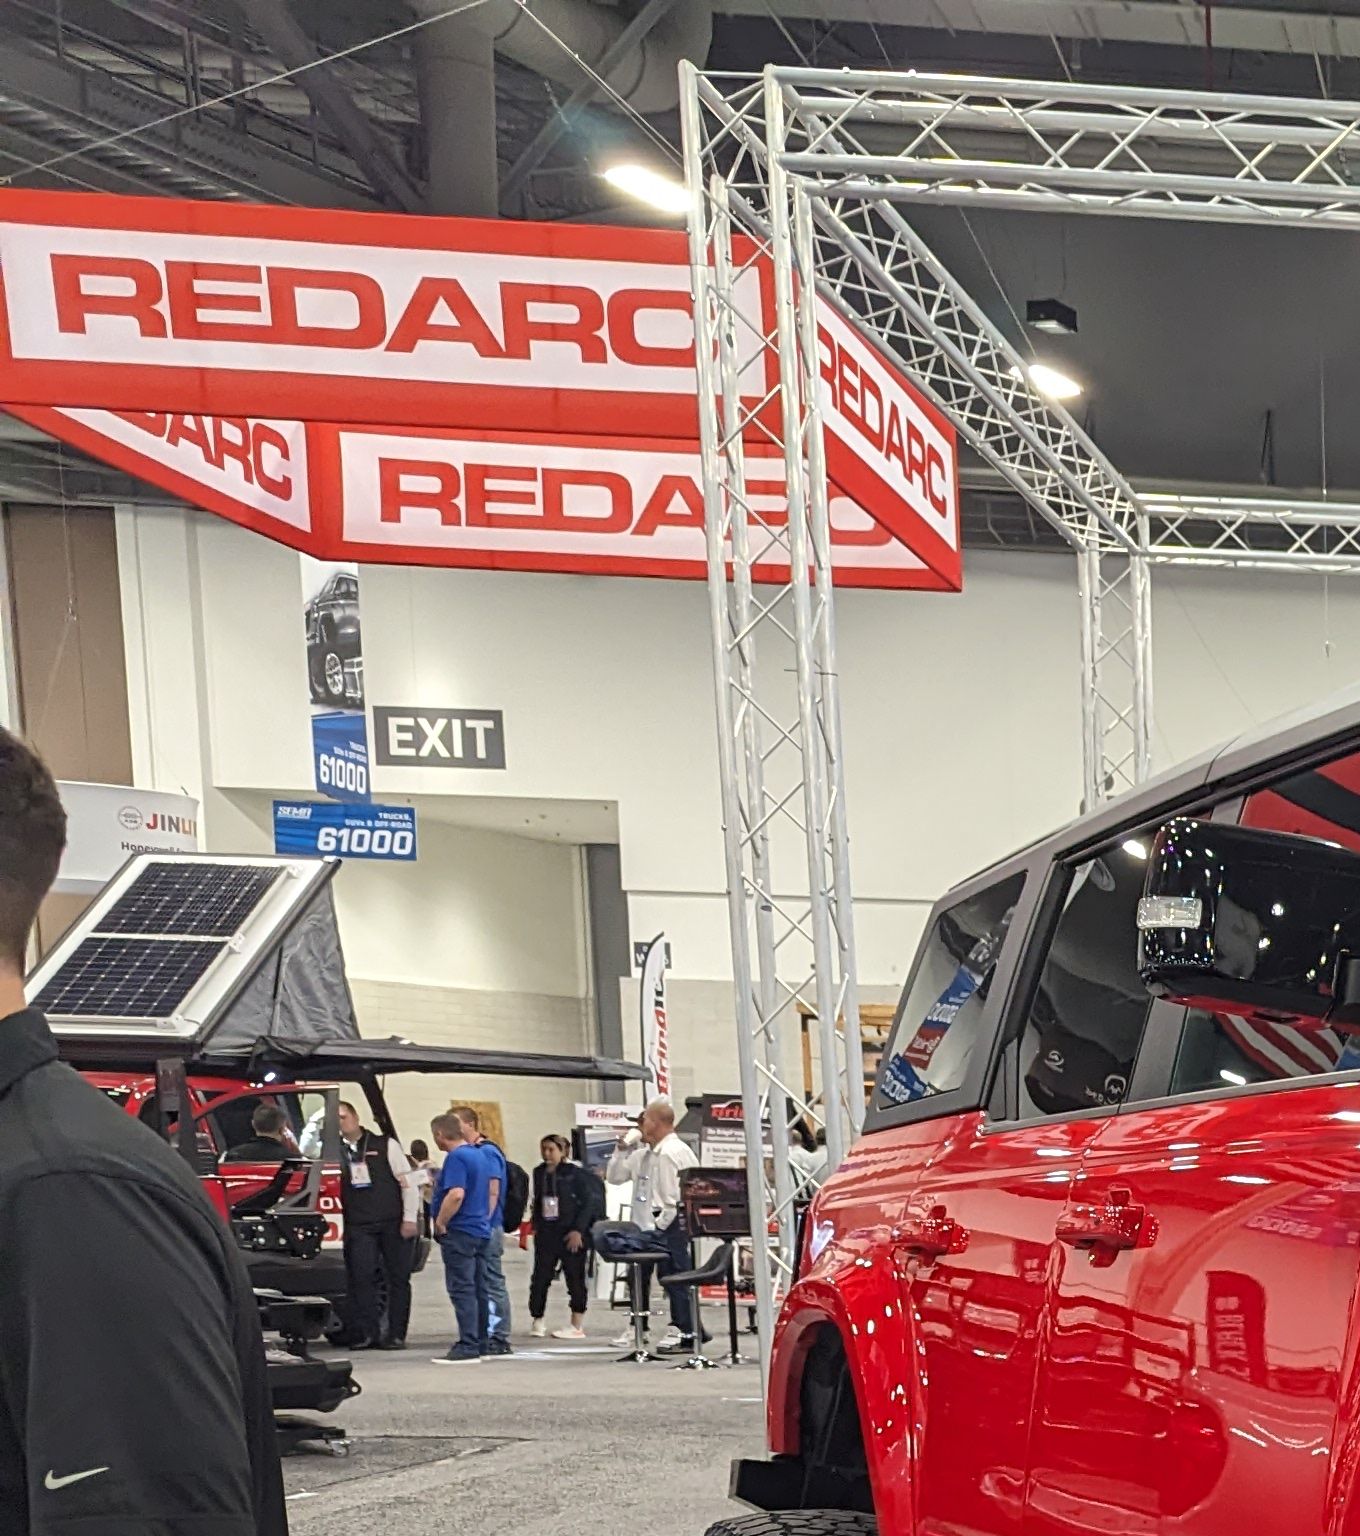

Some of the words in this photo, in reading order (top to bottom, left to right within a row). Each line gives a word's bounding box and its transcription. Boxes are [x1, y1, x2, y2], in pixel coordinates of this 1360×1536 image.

[50, 253, 717, 368] REDARC
[108, 411, 292, 501] ARC
[387, 716, 495, 759] EXIT
[319, 752, 367, 795] 61000
[317, 827, 414, 856] 61000
